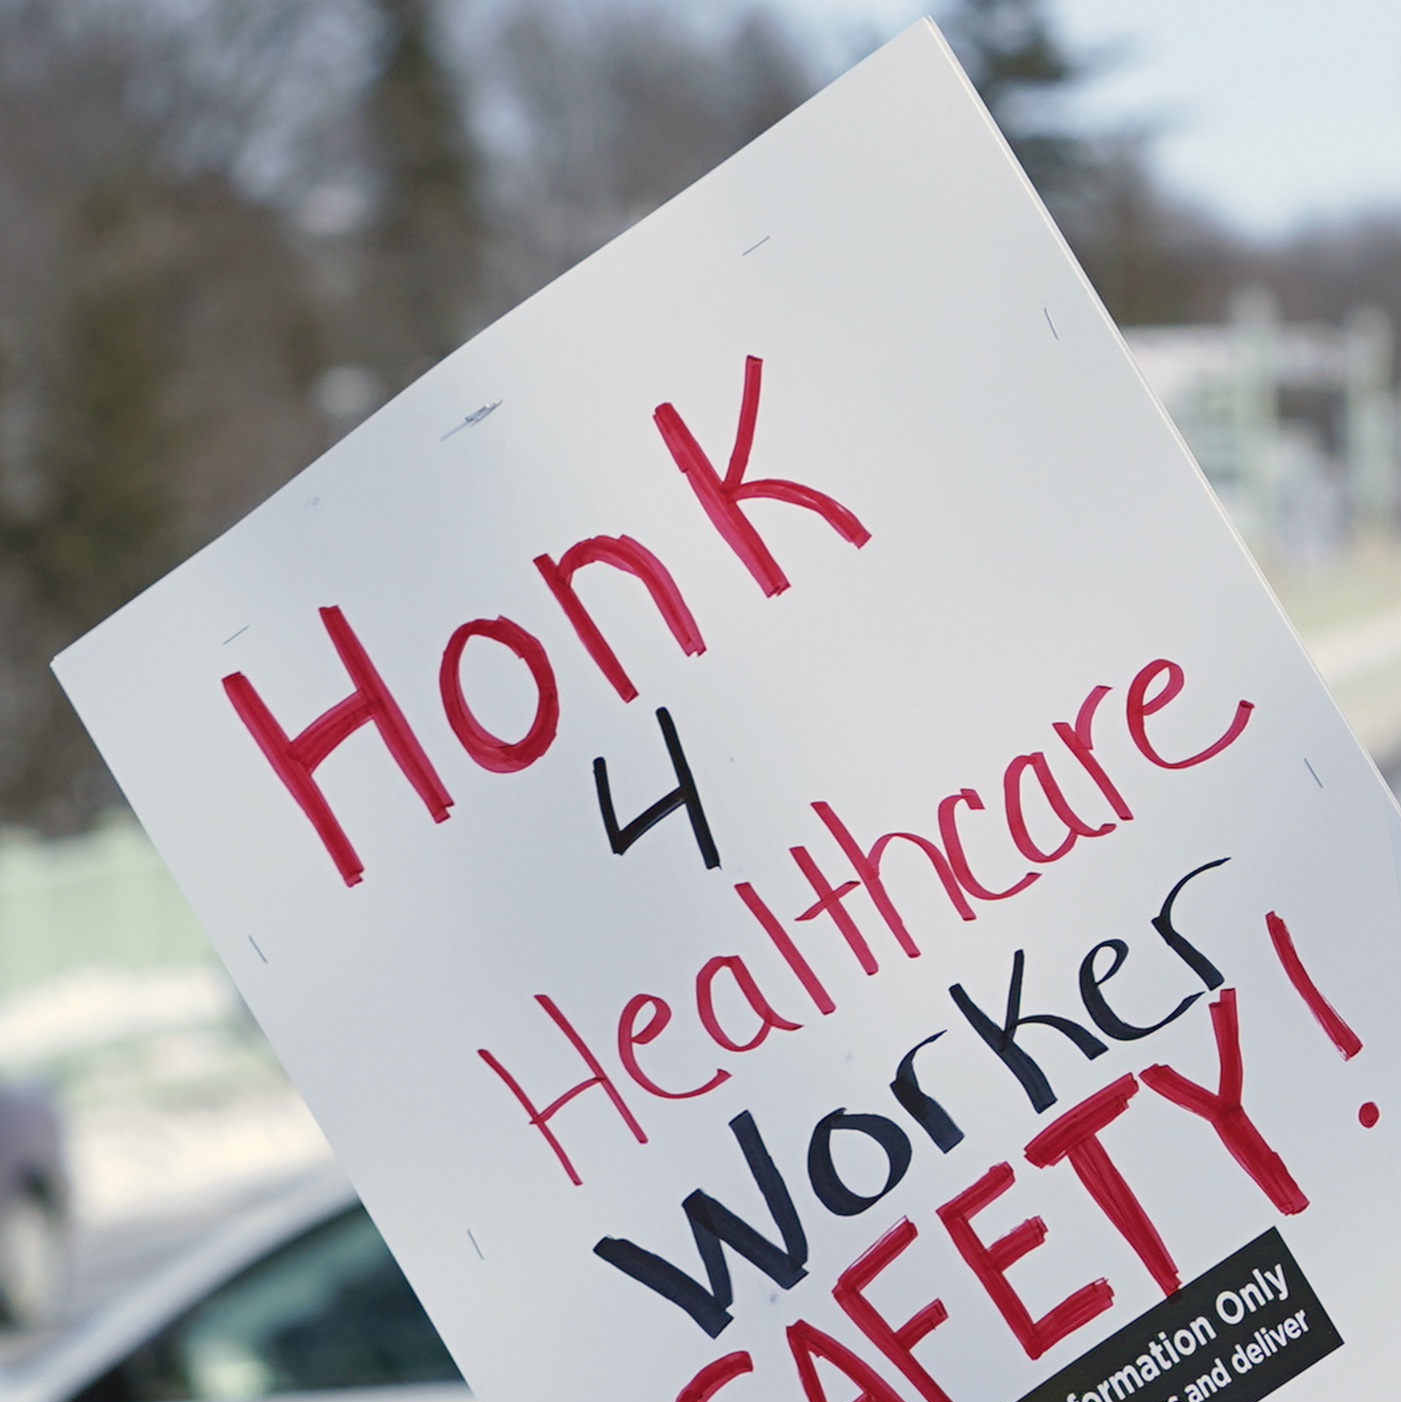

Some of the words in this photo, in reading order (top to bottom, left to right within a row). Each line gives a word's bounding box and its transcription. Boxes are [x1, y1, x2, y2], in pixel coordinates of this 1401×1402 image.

[592, 706, 721, 871] 4
[479, 656, 1255, 1187] Healthcare
[1215, 1262, 1291, 1327] Only
[1230, 1308, 1312, 1375] deliver
